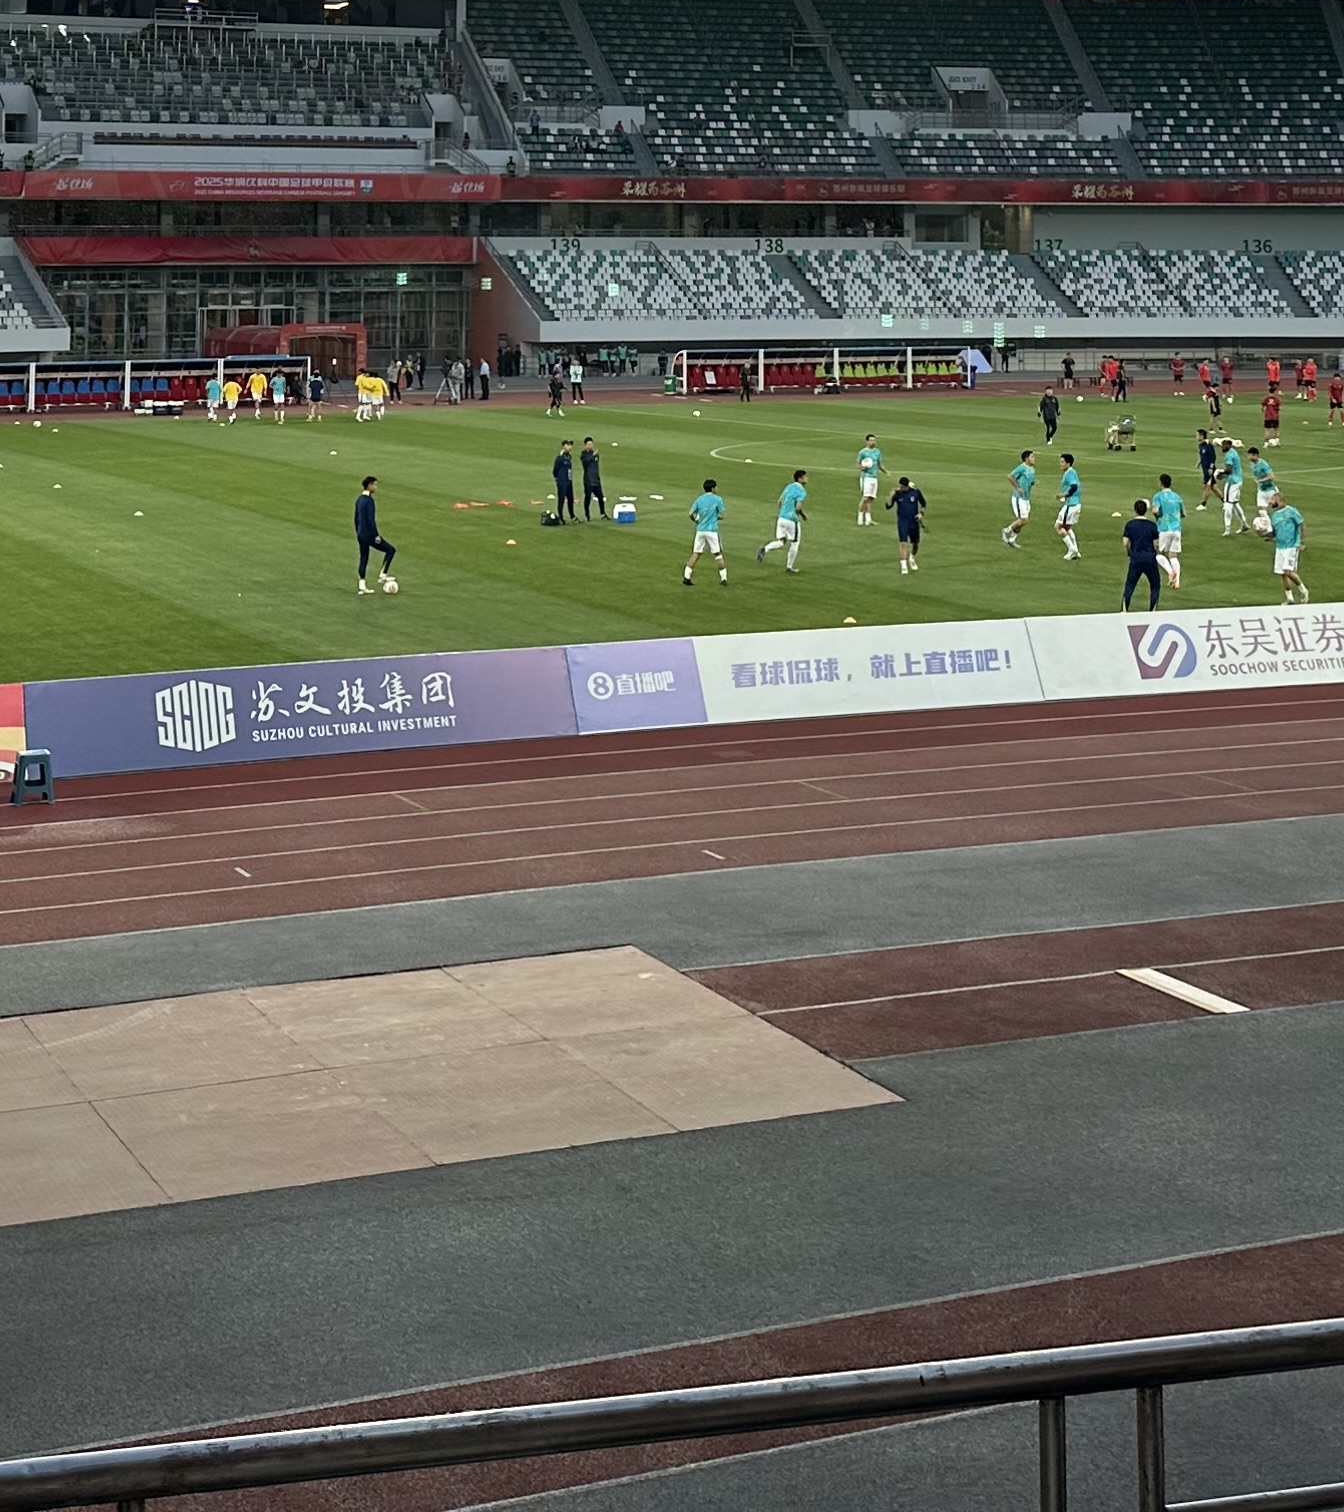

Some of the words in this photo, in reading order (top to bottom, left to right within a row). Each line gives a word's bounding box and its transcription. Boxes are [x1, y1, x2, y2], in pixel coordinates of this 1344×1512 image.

[550, 238, 581, 253] 139
[754, 238, 784, 253] 138
[1035, 239, 1063, 252] 137
[1243, 239, 1273, 253] 136
[1209, 660, 1280, 677] SOOCHOW
[615, 670, 676, 695] 直播吧
[250, 671, 456, 723] 苏文投集团
[252, 725, 305, 744] SUZHOU
[308, 721, 374, 739] CULTURAL
[377, 715, 457, 734] INVESTMENT
